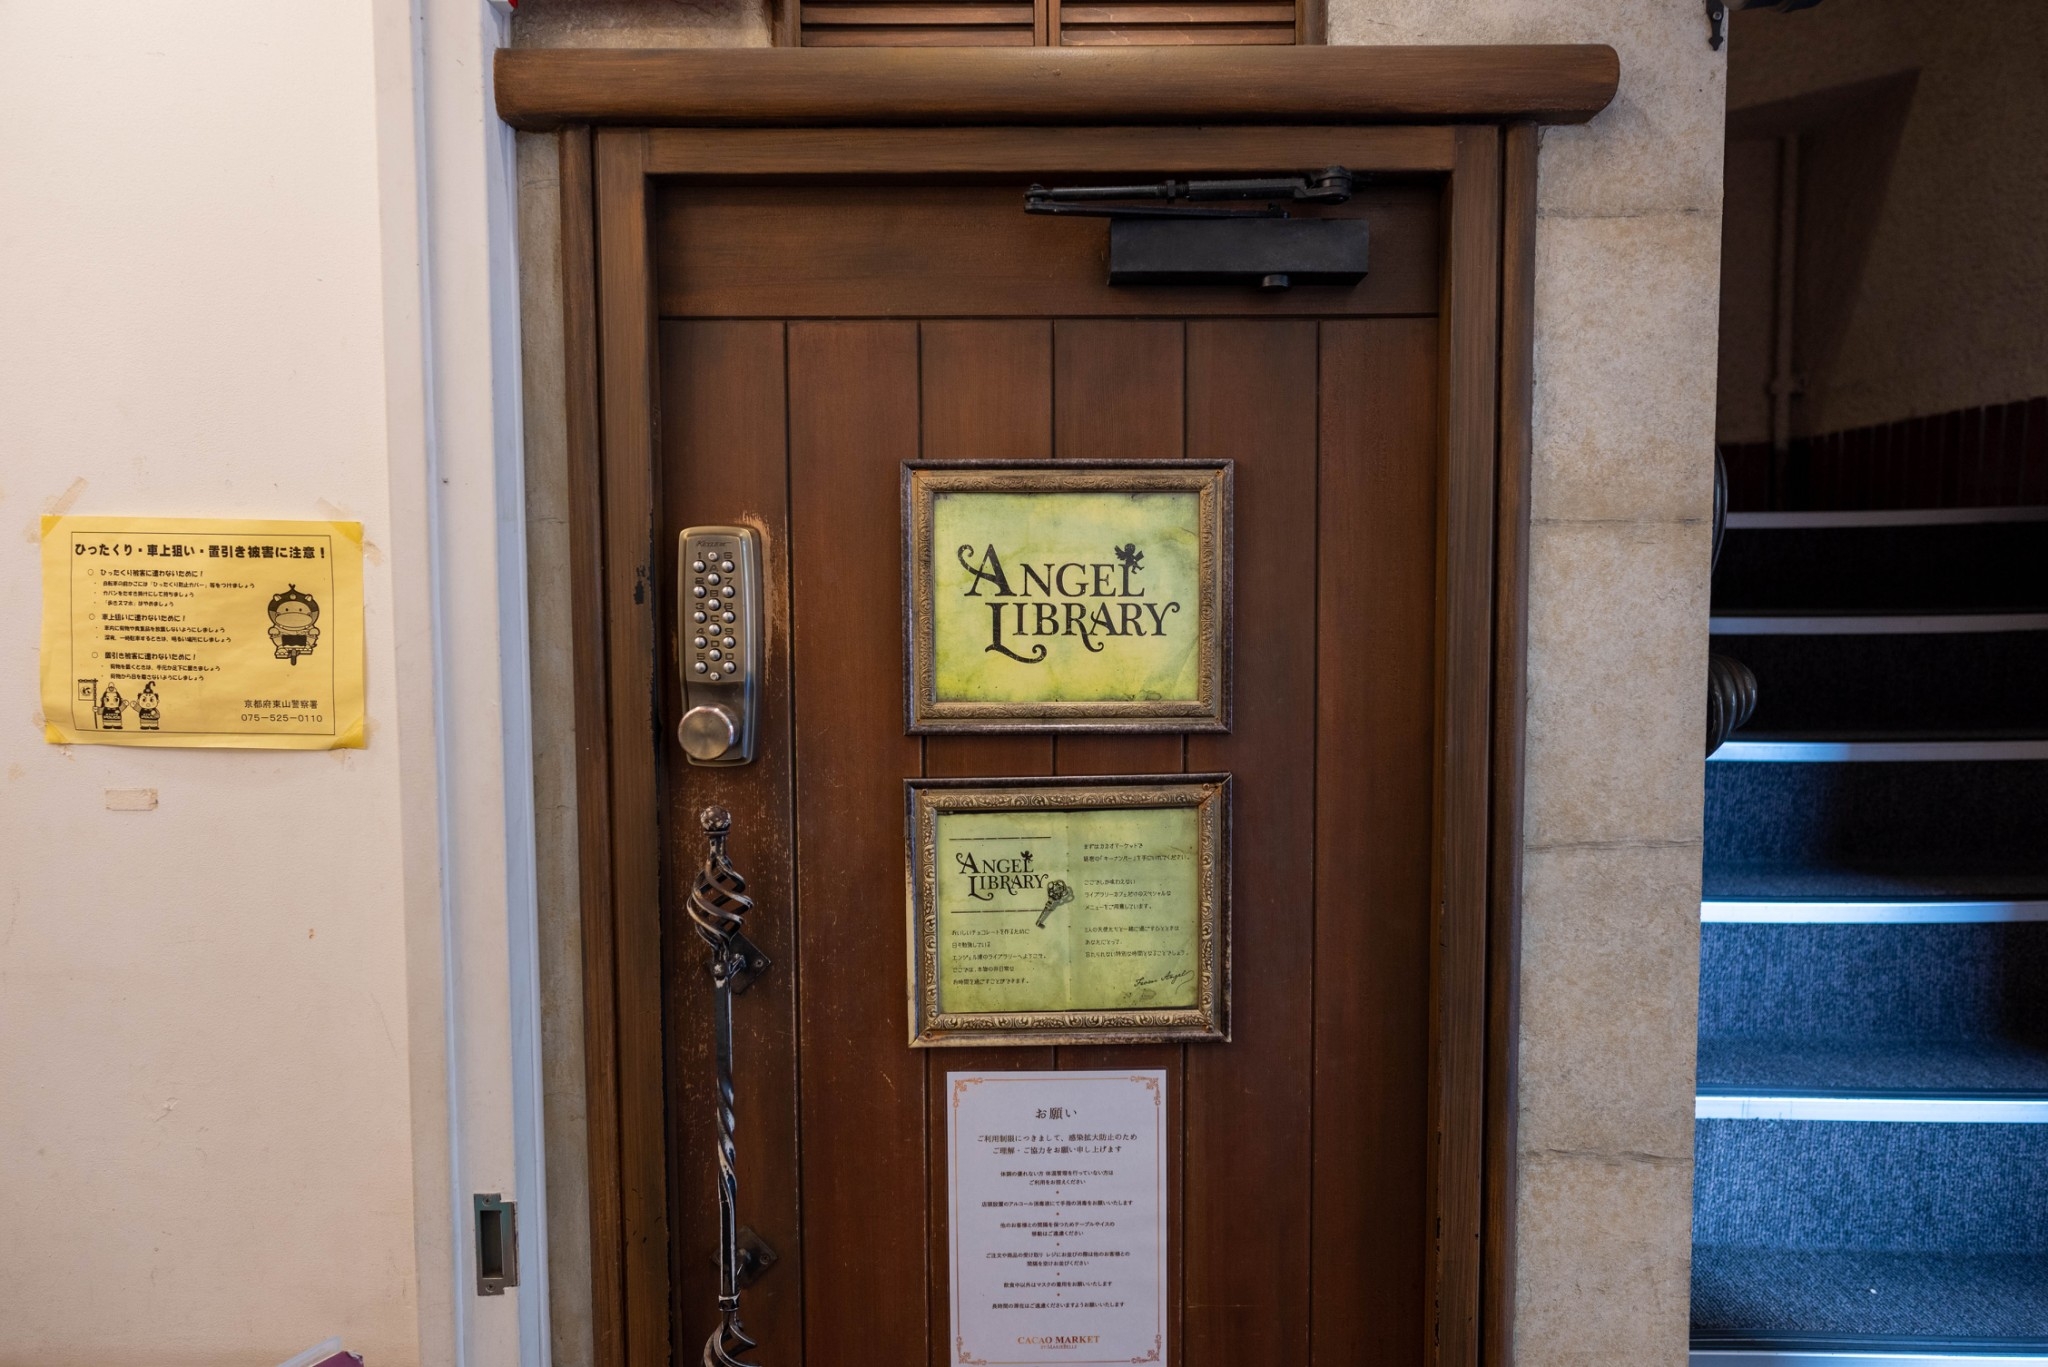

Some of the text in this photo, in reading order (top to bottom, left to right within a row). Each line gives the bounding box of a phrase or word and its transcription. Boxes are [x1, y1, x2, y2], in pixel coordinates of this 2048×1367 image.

[74, 543, 326, 560] ひったくり・車上狙い・置引き被害に注意！
[957, 543, 1145, 597] ANGEL
[985, 602, 1180, 664] LIBRARY
[244, 699, 319, 709] 京都府東山警察署
[956, 850, 1034, 874] ANGEL
[968, 874, 1049, 901] LIBRARY
[1035, 1107, 1078, 1120] お願い
[1018, 1336, 1052, 1344] CACAO
